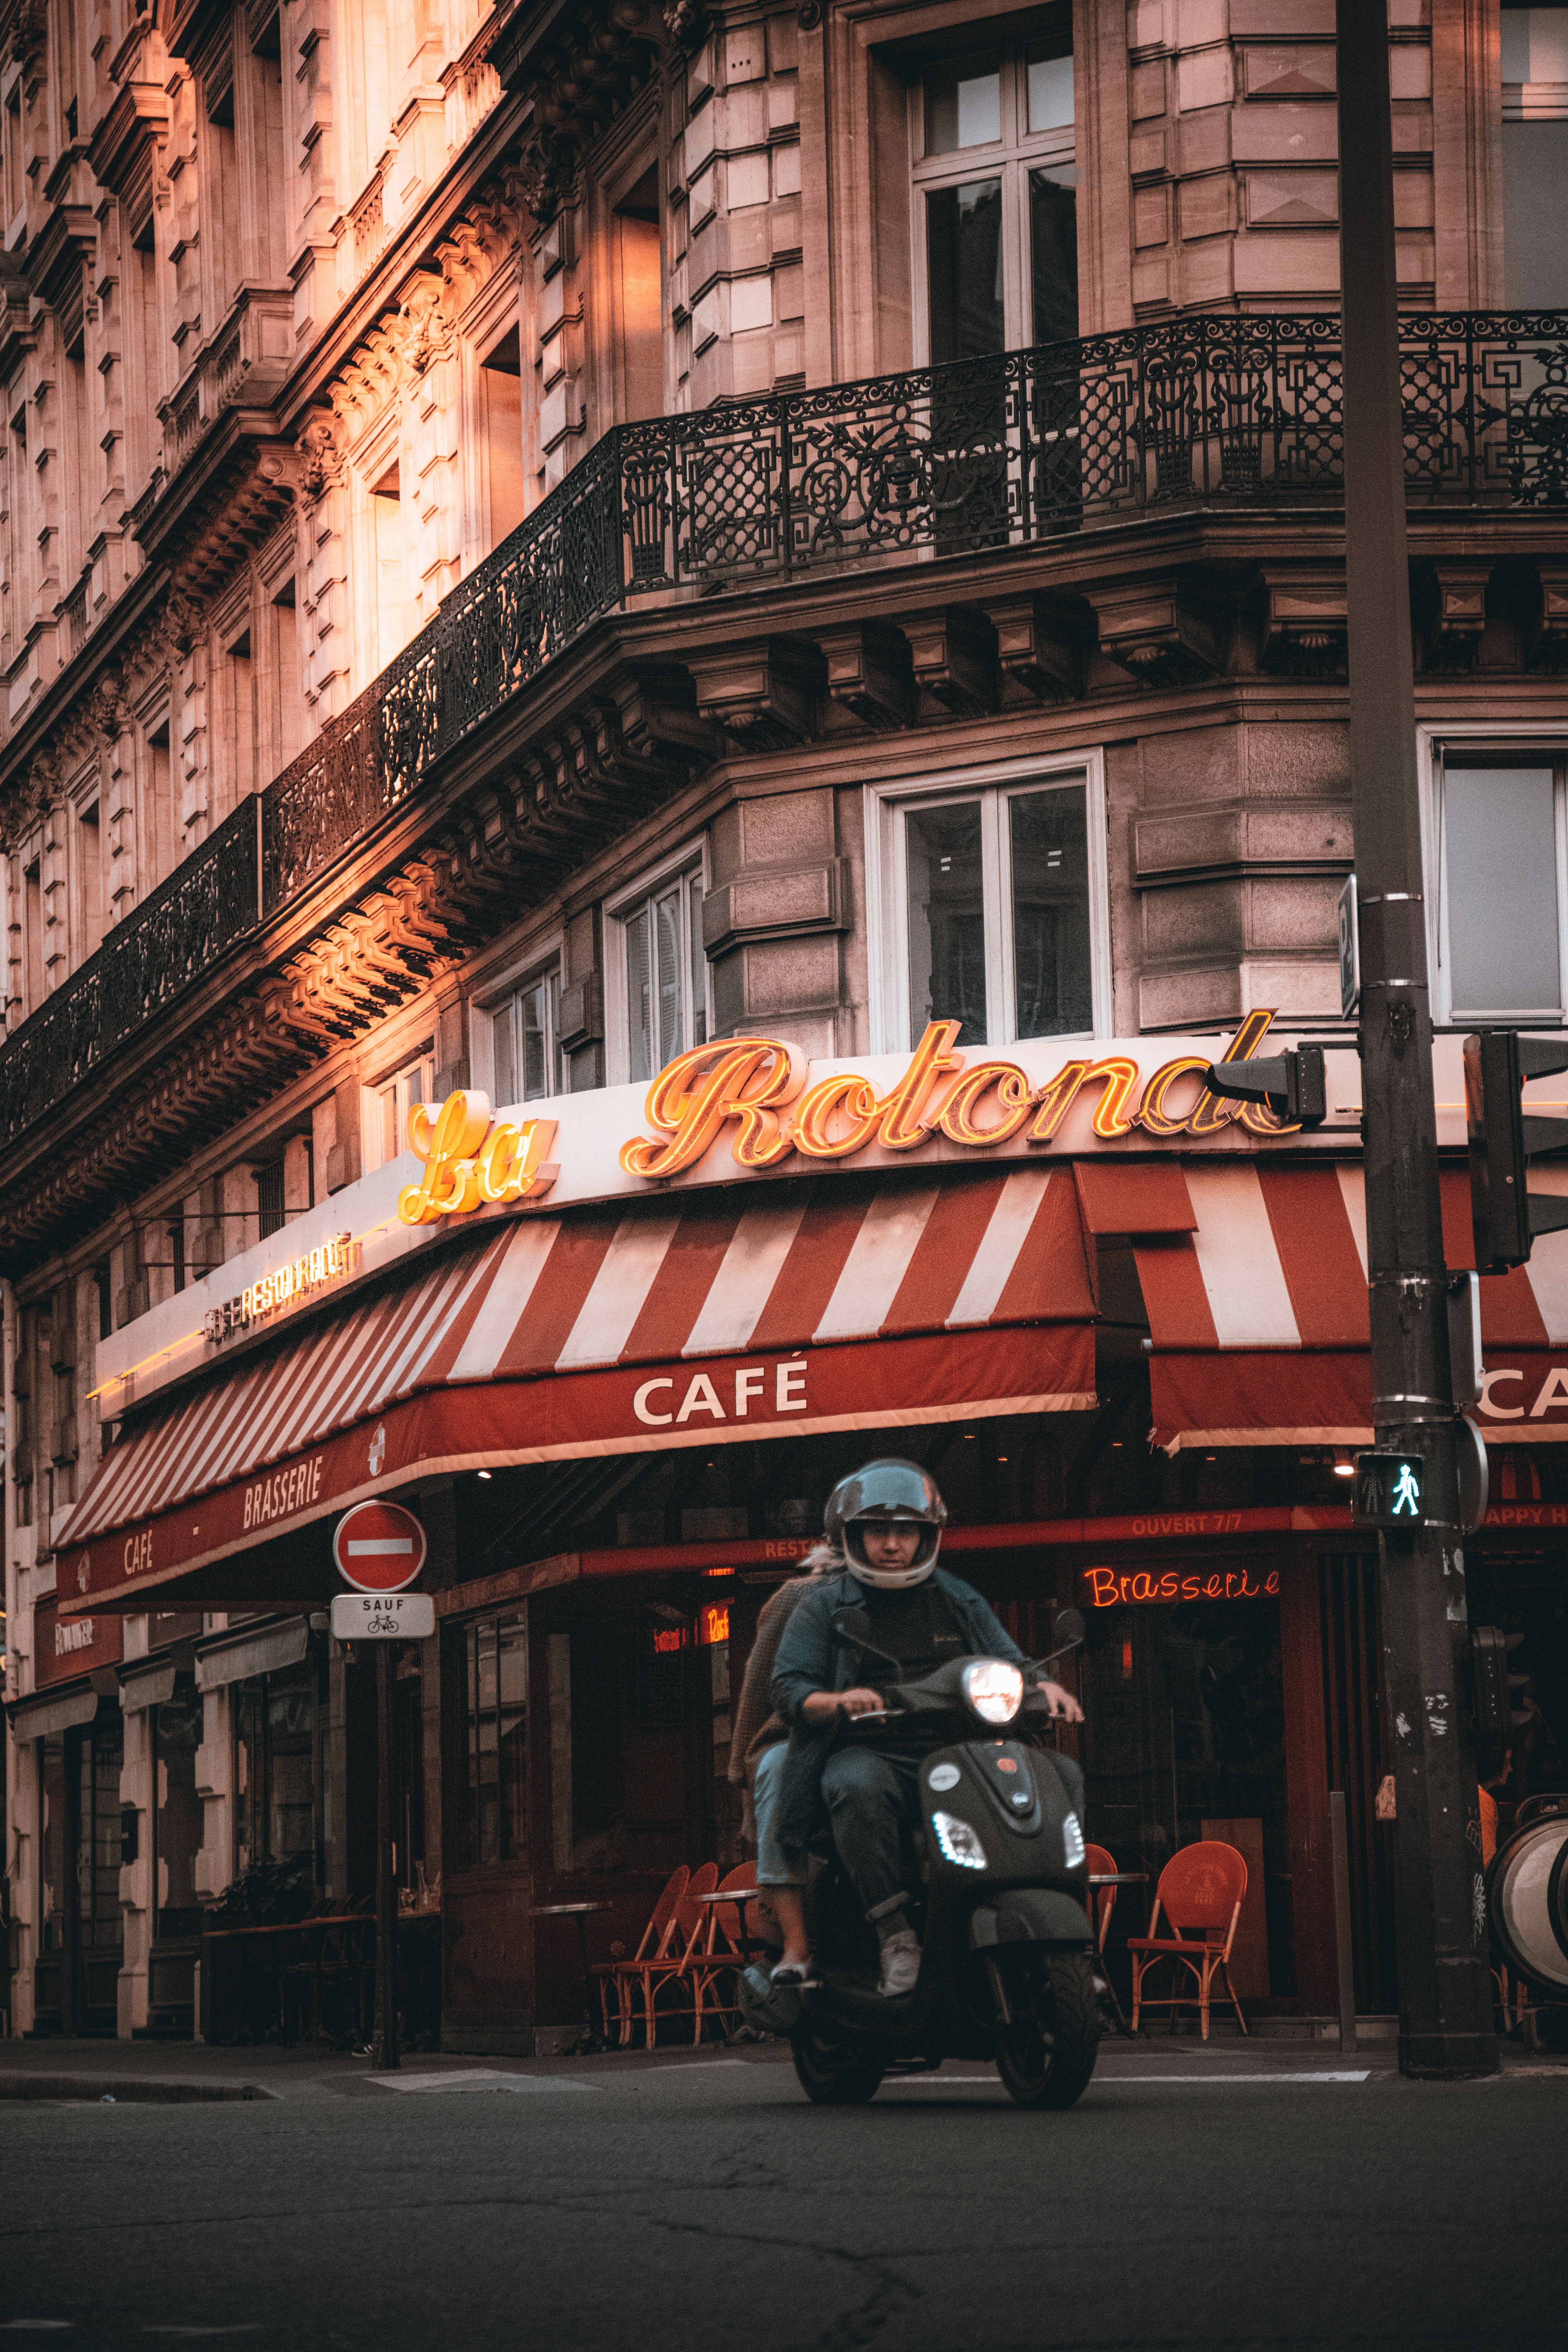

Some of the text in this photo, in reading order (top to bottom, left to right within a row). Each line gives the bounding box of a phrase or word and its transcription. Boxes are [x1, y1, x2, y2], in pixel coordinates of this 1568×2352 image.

[397, 1089, 560, 1226] La
[242, 1233, 351, 1322] RESTAURANT
[633, 1351, 808, 1425] CAFÉ
[243, 1455, 323, 1530] BRASSERIE
[1132, 1513, 1243, 1536] OUVERT 7/7
[1484, 1508, 1544, 1524] APPY
[766, 1540, 819, 1558] REST
[363, 1599, 404, 1611] SAUF
[1084, 1567, 1280, 1607] Brasserie
